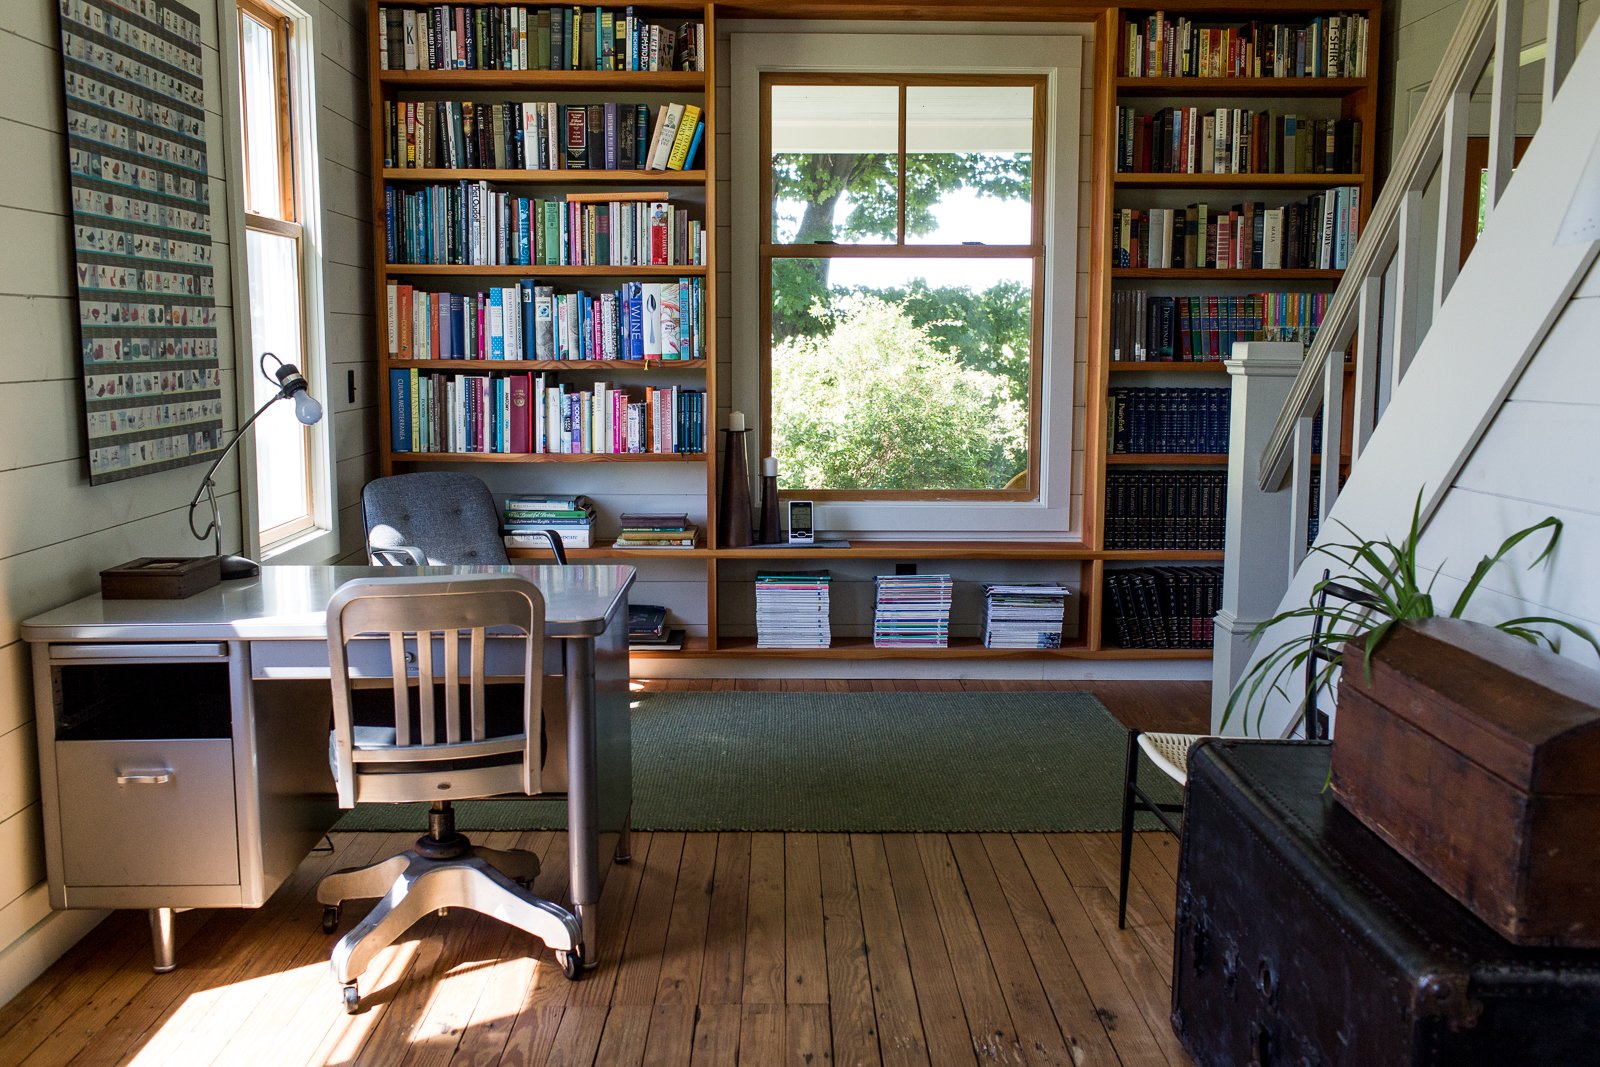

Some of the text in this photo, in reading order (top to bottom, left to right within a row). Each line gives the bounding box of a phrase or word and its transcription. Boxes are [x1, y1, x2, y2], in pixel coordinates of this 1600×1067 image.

[1328, 25, 1340, 68] T-SHIRT
[670, 114, 690, 162] EVERYTHING
[688, 116, 697, 133] HOW
[678, 144, 688, 162] COOK
[1324, 211, 1333, 247] ARCADIA
[631, 305, 641, 340] WINE
[1162, 307, 1170, 350] DICTIONARY
